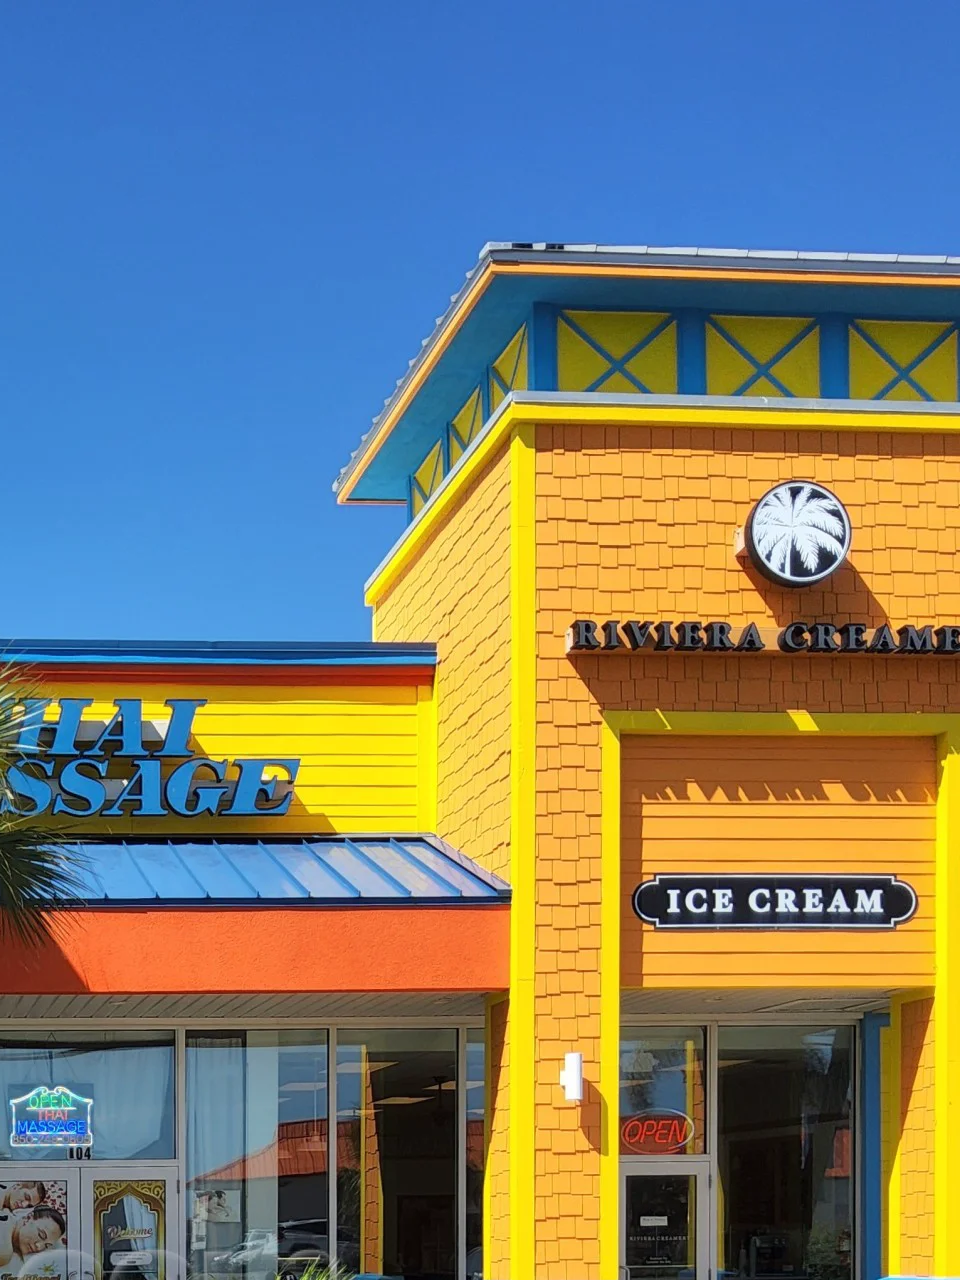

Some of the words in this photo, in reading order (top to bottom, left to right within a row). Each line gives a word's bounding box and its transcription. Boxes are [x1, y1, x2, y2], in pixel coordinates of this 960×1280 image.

[572, 620, 765, 653] RIVIERA
[667, 889, 734, 913] ICE
[748, 889, 884, 913] CREAM
[29, 1094, 72, 1108] OPEN
[37, 1109, 69, 1120] THAI
[16, 1120, 86, 1133] MASSAGE
[624, 1120, 688, 1143] OPEN
[69, 1147, 91, 1160] 104
